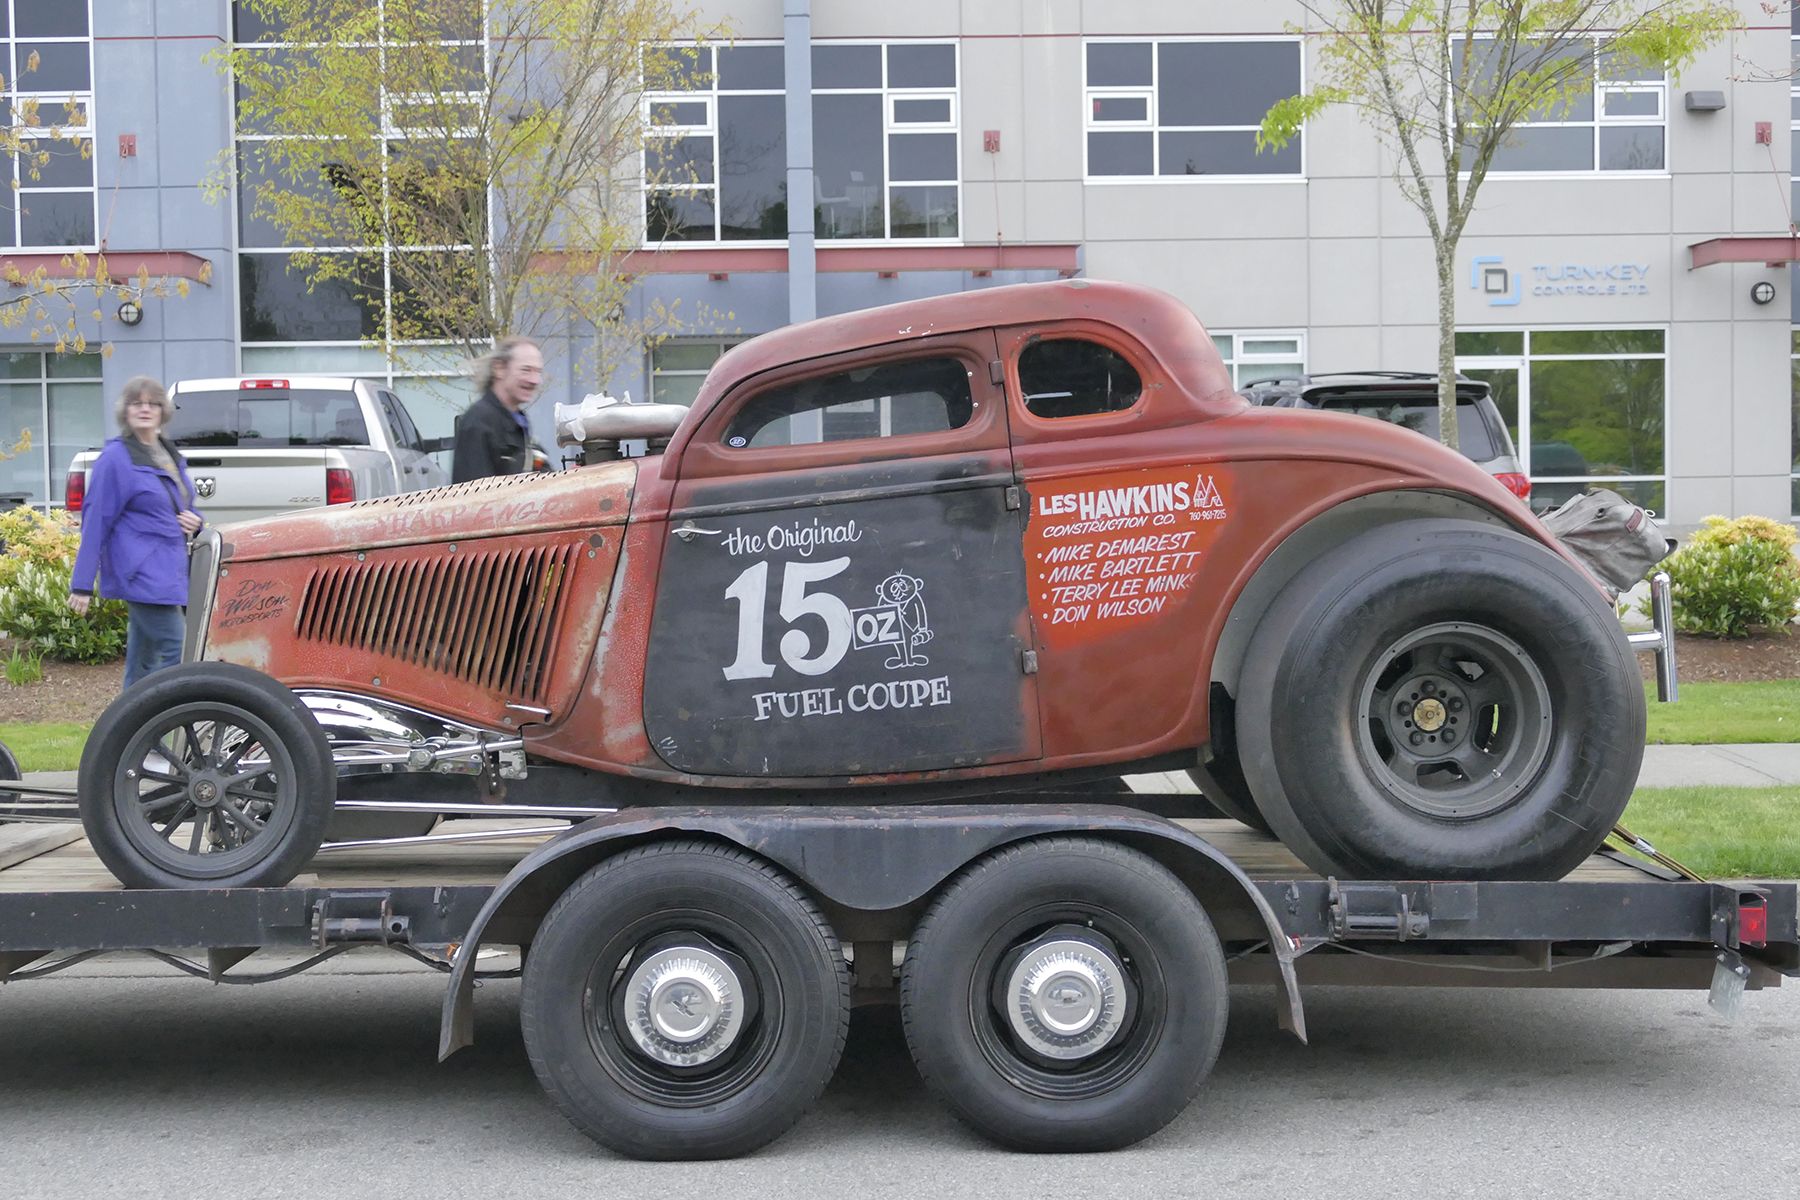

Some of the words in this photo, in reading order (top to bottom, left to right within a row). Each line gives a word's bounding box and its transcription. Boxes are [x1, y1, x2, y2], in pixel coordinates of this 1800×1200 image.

[1532, 264, 1650, 281] TURN-KEY
[1532, 285, 1616, 297] CONTROLS
[1039, 493, 1078, 516] LES
[1079, 481, 1190, 521] HAWKINS
[721, 527, 765, 556] the
[767, 518, 862, 557] Original
[1042, 515, 1148, 538] CONSTRUCTION
[1153, 513, 1176, 526] CO.
[1044, 543, 1093, 564] MIKE
[1096, 531, 1196, 559] DEMAREST
[1047, 561, 1097, 584] MIKE
[1100, 551, 1201, 579] BARTLETT
[1051, 581, 1109, 605] TERRY
[1109, 578, 1144, 598] LEE
[722, 556, 853, 681] 15
[1051, 605, 1090, 625] DON
[1097, 596, 1167, 620] WILSON
[856, 611, 900, 643] OZ
[752, 687, 843, 721] FUEL
[847, 675, 951, 712] COUPE
